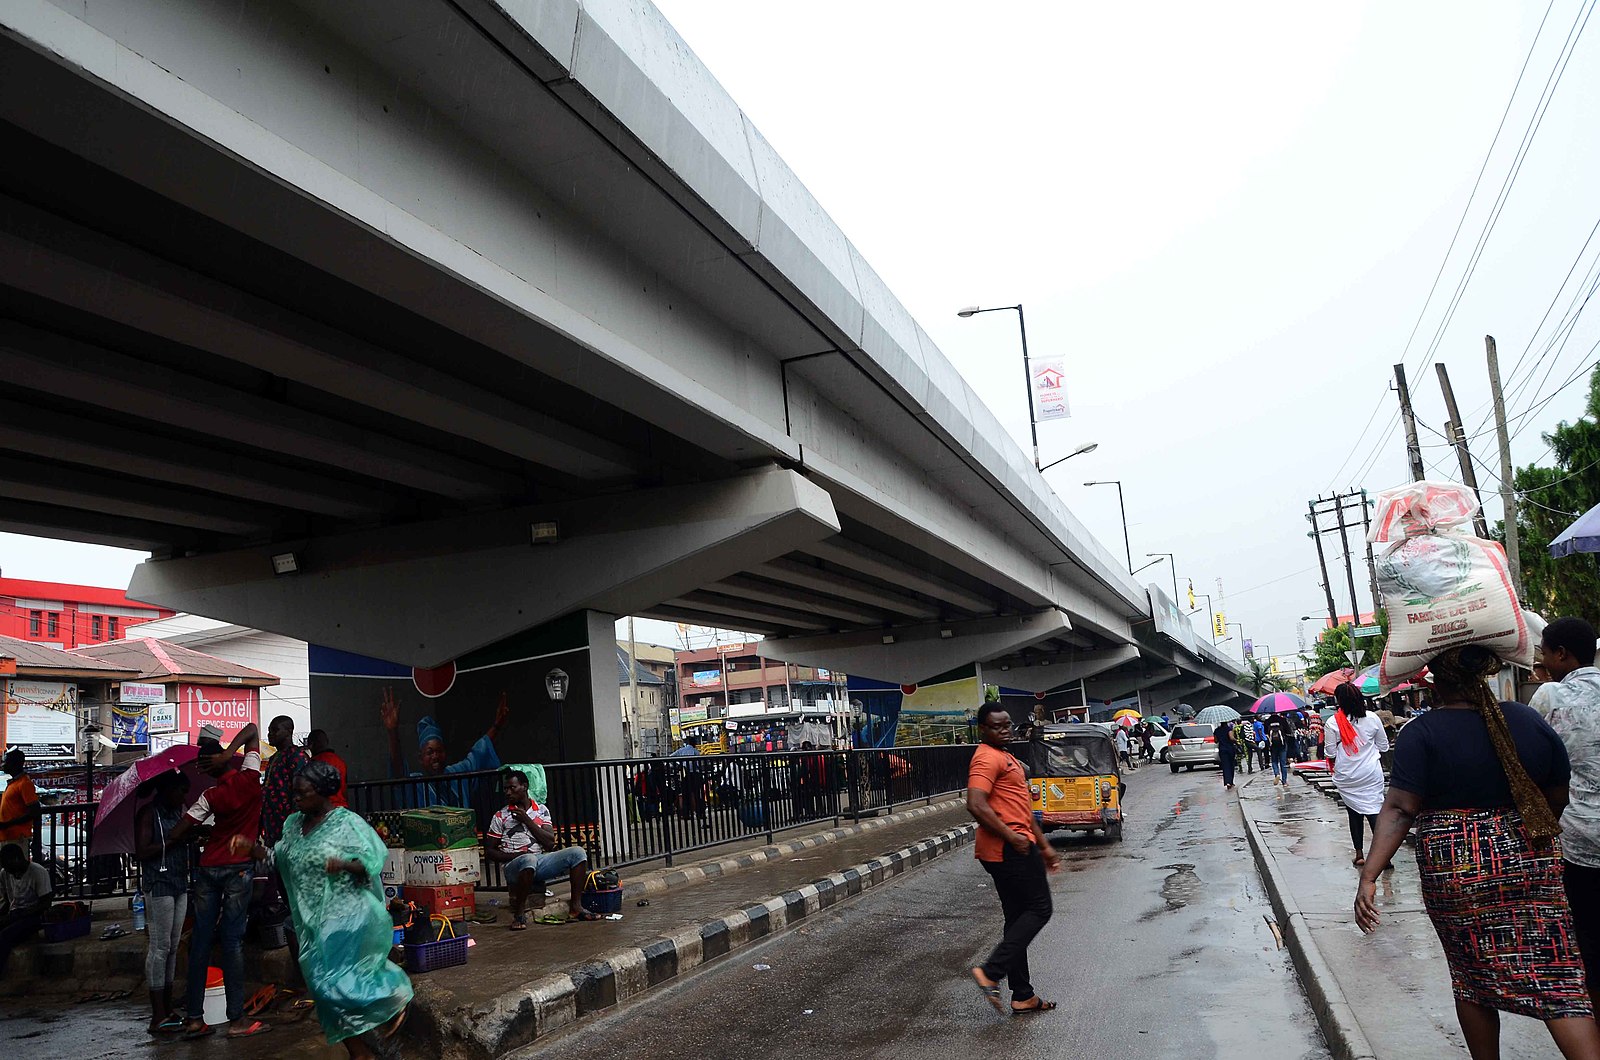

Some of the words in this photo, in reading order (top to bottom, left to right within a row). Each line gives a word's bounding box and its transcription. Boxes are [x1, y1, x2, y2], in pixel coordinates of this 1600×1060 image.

[195, 689, 249, 717] bontel
[196, 719, 225, 729] SERVICE
[52, 776, 77, 786] PLACE
[413, 855, 445, 864] KROMCO
